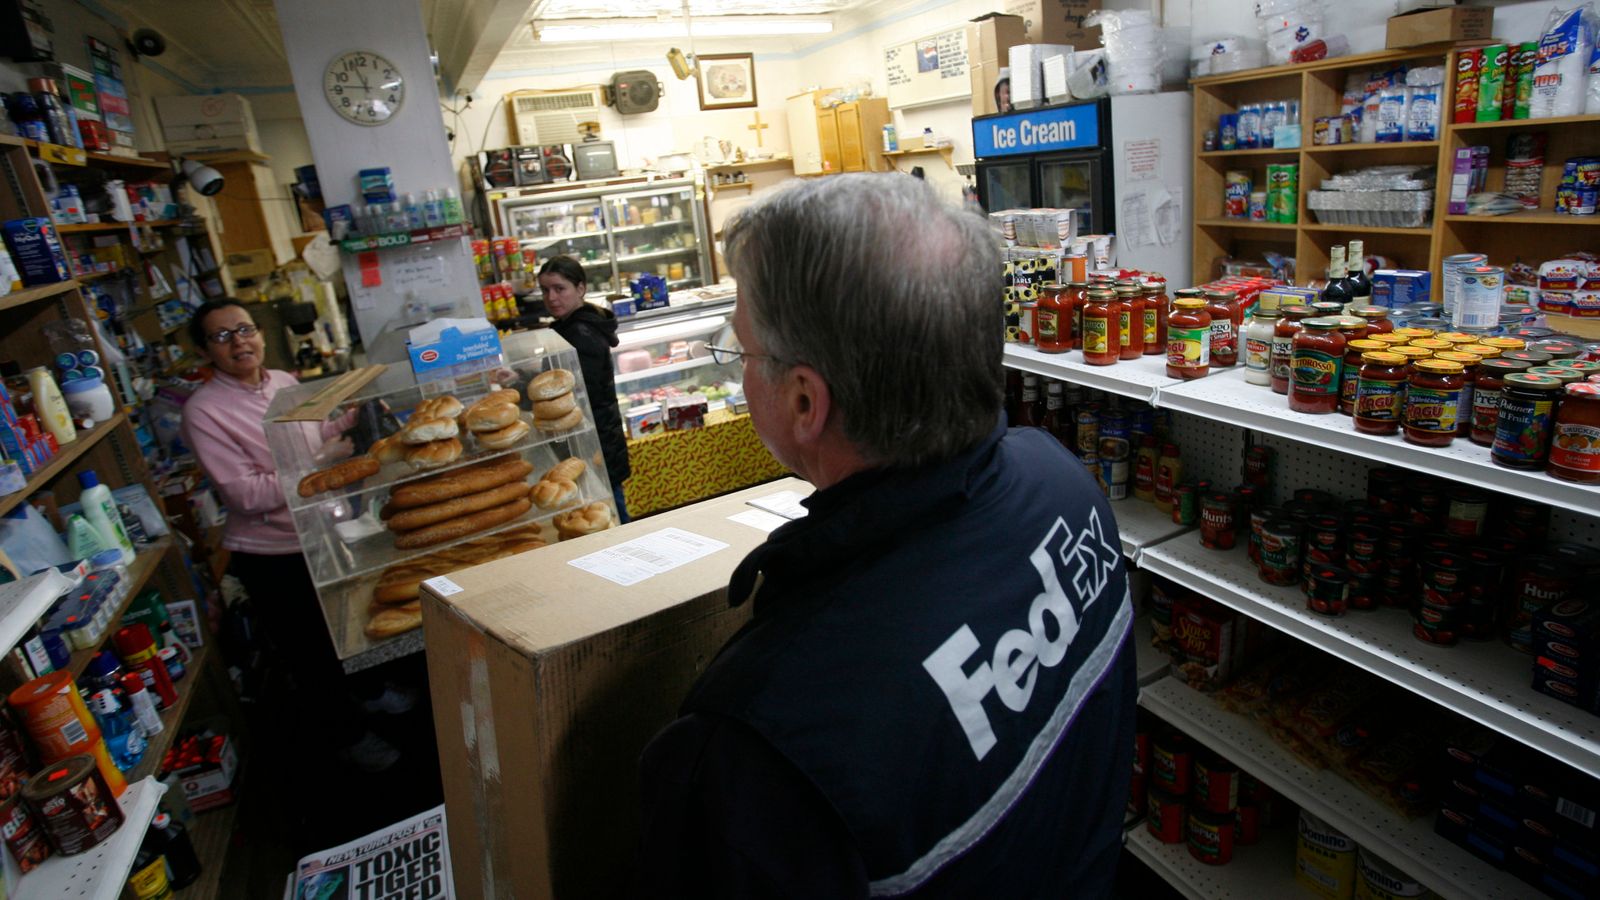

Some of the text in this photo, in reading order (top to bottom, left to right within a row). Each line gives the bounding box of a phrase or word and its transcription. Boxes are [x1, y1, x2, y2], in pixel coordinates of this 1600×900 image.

[992, 119, 1076, 149] Ice Cream
[377, 234, 408, 247] BOLD
[1209, 323, 1231, 334] ego
[1273, 341, 1292, 354] rego
[1475, 391, 1500, 407] Pre
[1500, 399, 1534, 414] Polaner
[1562, 426, 1600, 438] SMUCKER
[922, 506, 1119, 762] FedEx
[355, 831, 440, 882] TOXIC
[355, 852, 441, 900] TIGER
